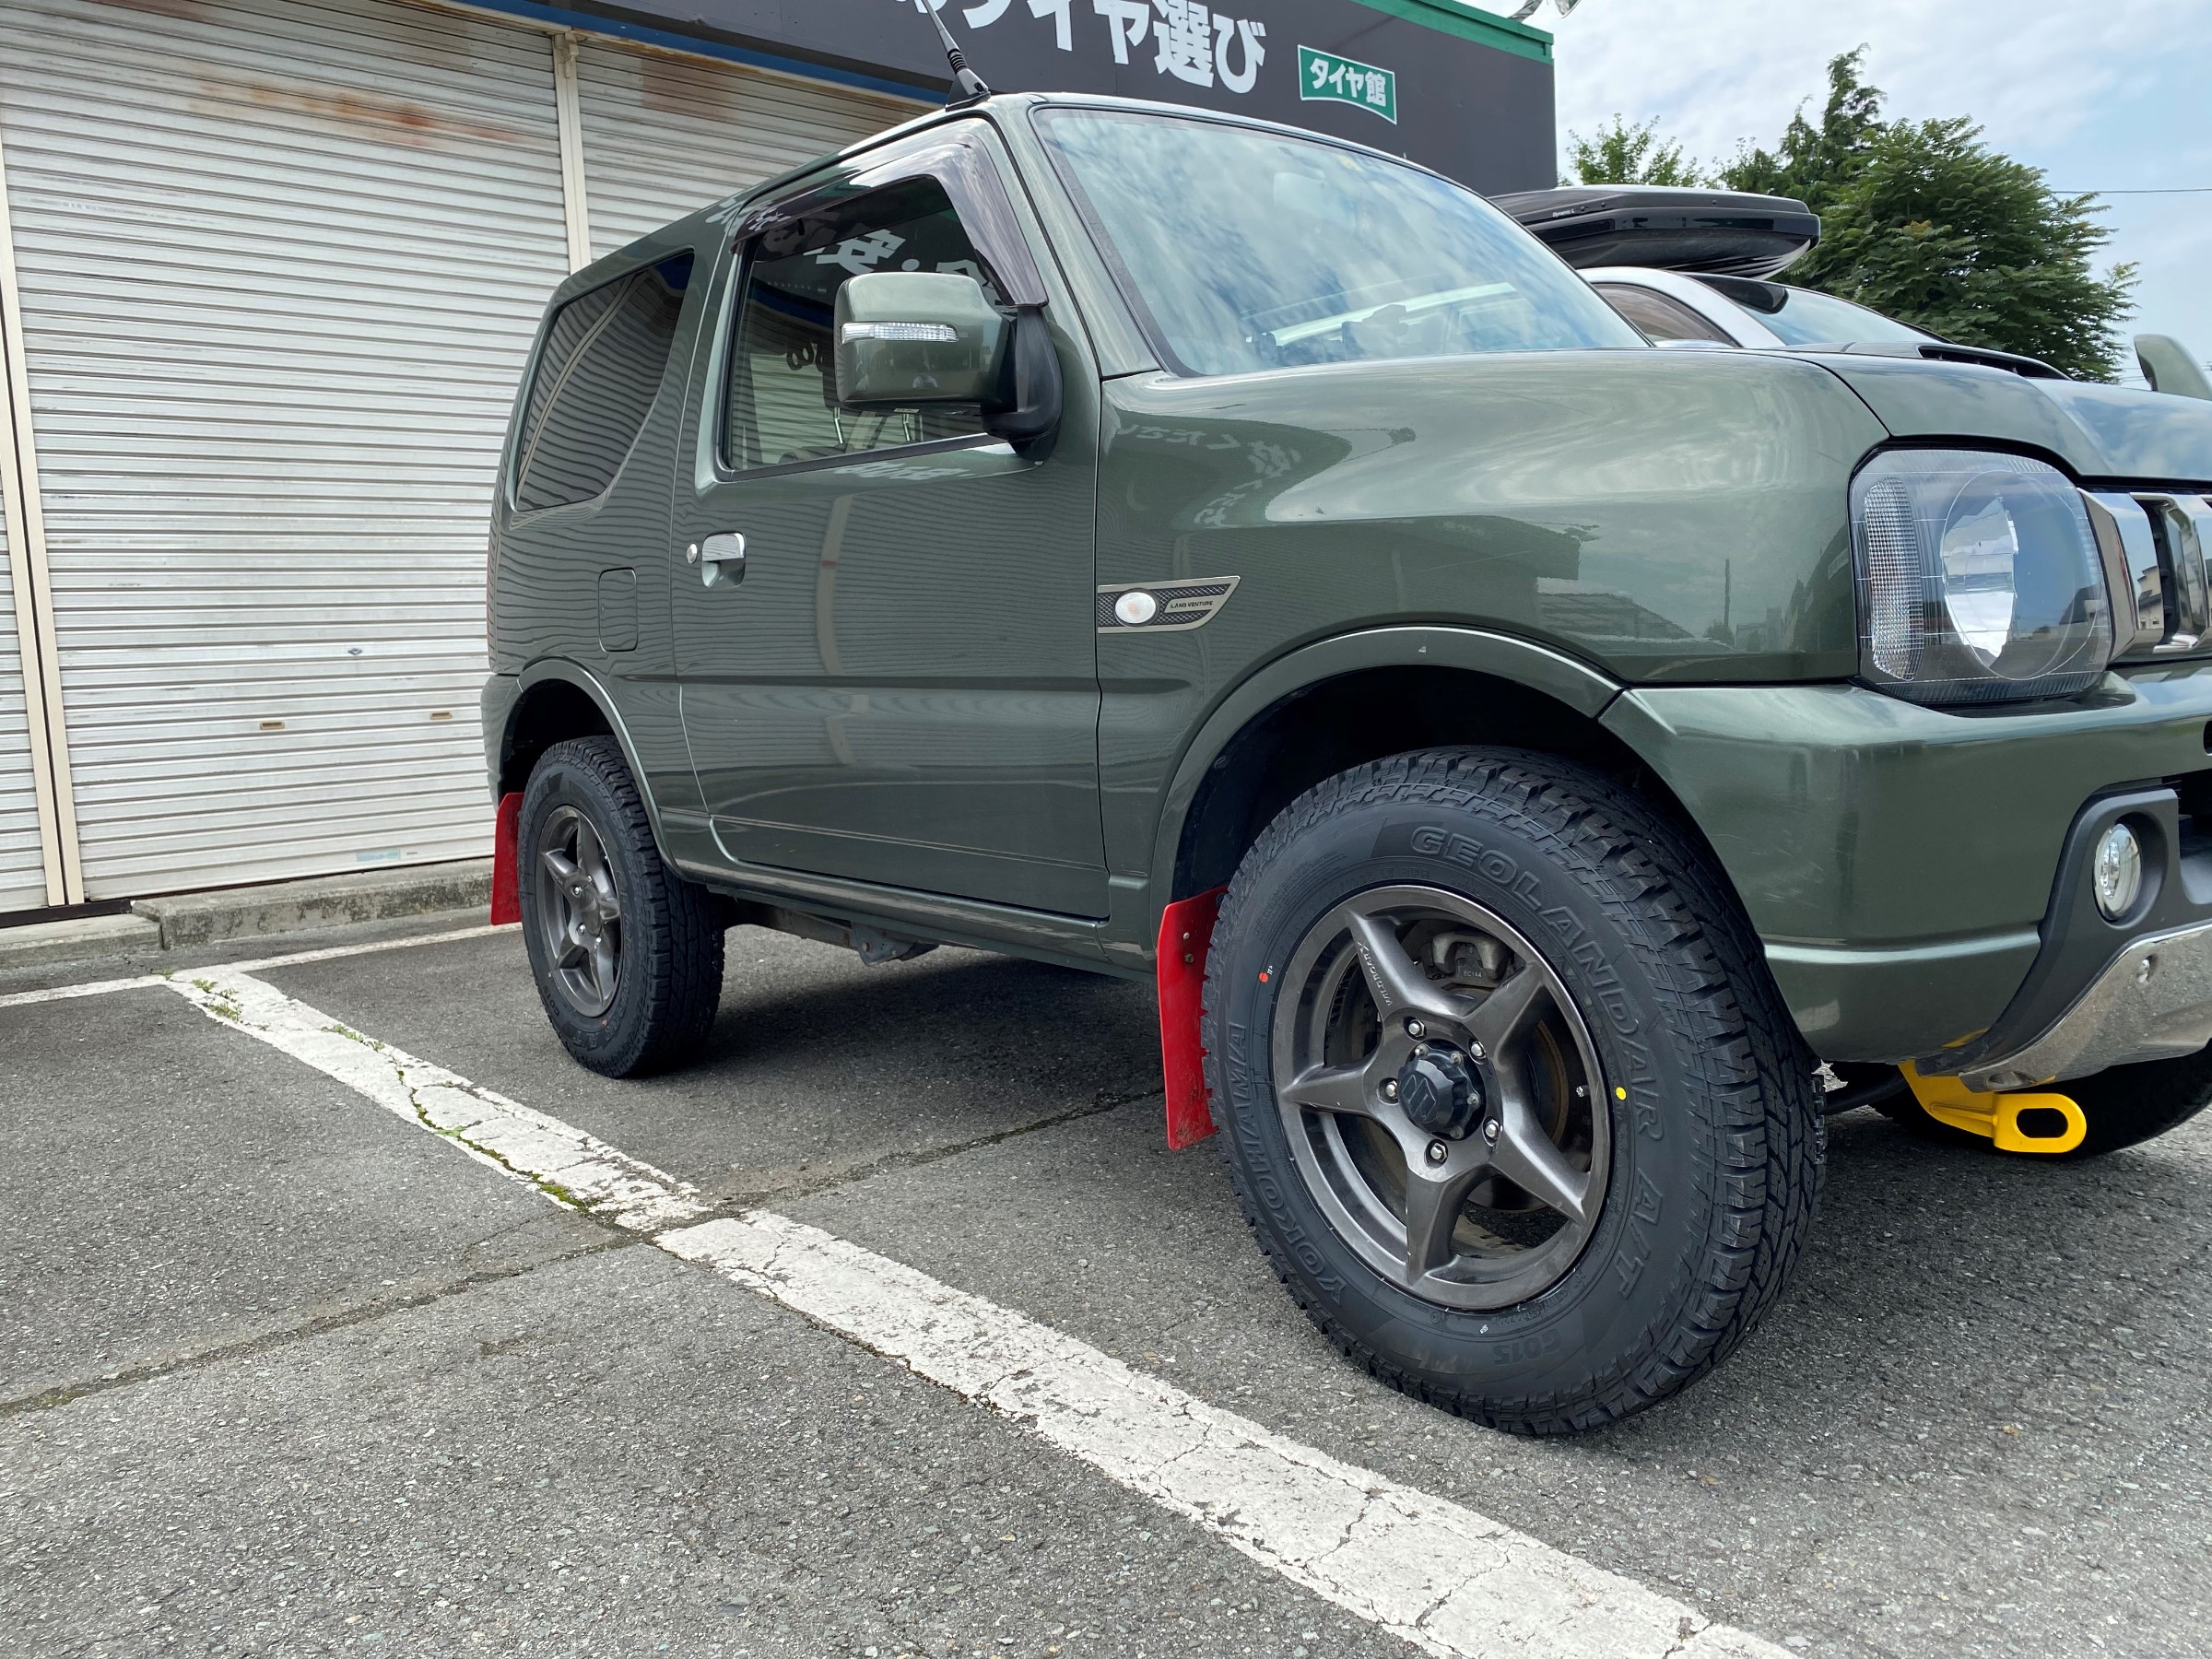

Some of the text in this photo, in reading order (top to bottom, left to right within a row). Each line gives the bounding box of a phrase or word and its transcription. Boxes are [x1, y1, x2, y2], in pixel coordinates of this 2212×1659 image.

[1310, 58, 1386, 107] タイヤ館
[1411, 826, 1664, 1141] GEOLANDAR
[1615, 1167, 1663, 1300] A/T
[1228, 1021, 1349, 1307] YOKOHAMA
[1492, 1328, 1562, 1367] G015
